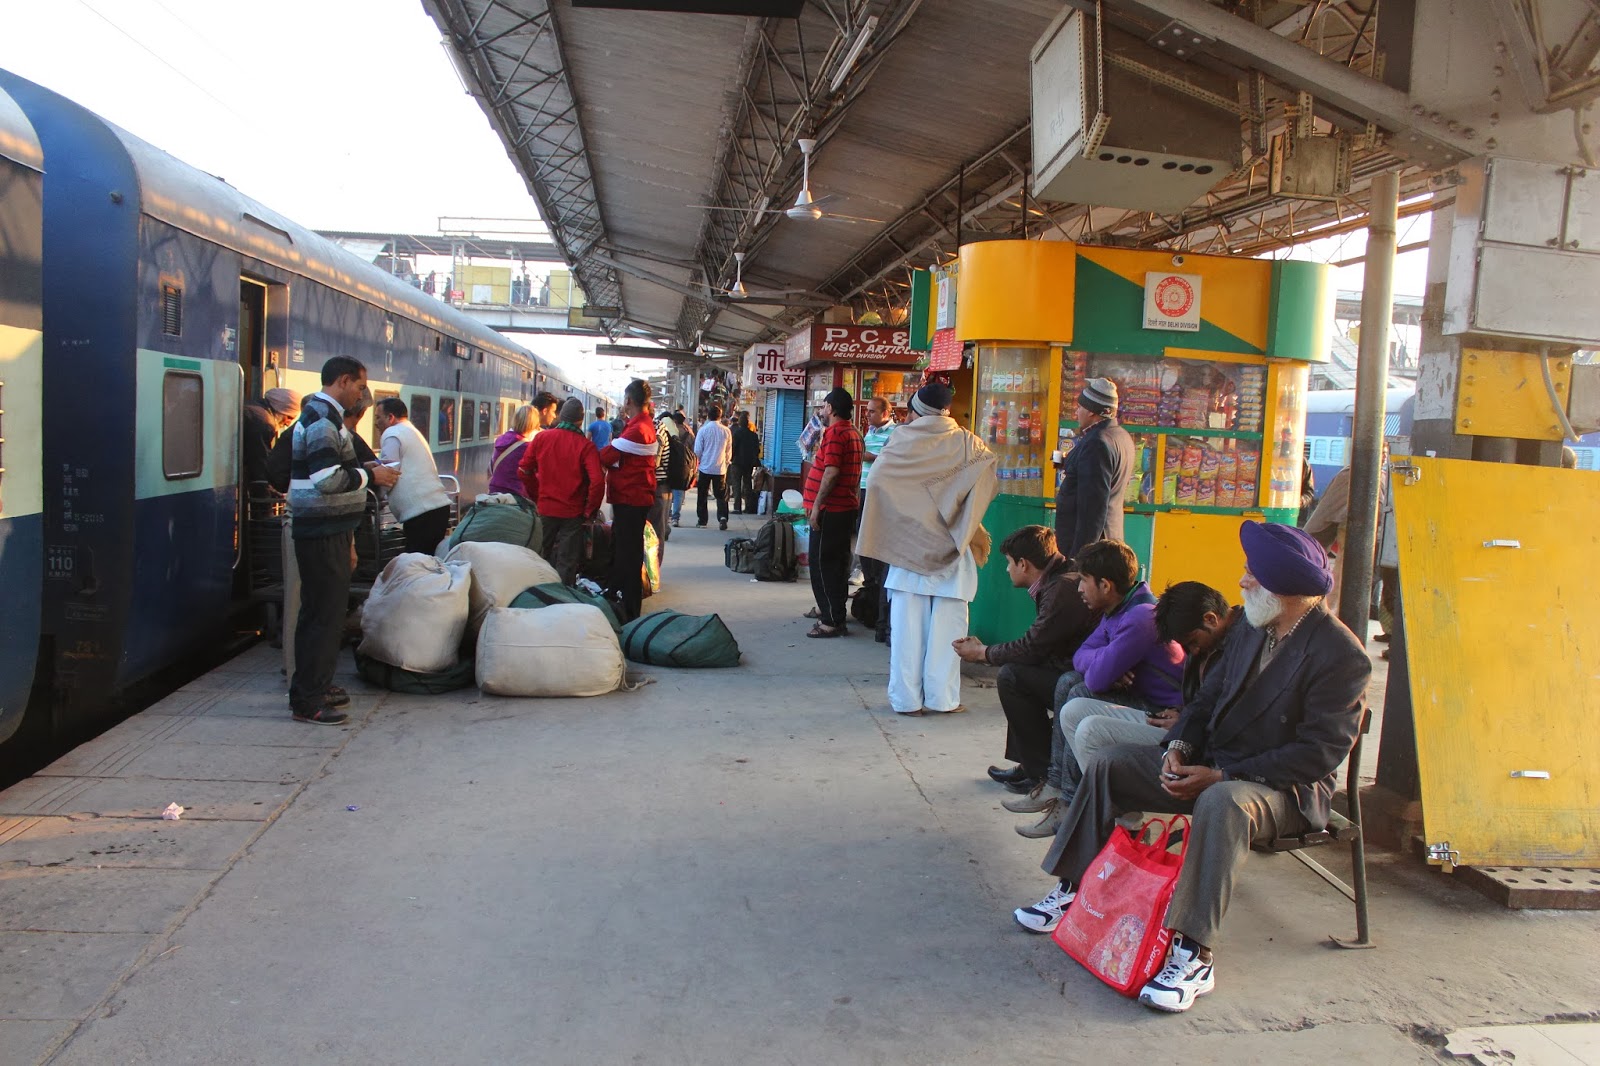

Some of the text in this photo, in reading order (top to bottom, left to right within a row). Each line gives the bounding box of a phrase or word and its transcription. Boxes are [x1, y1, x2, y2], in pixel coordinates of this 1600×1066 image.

[821, 342, 863, 353] MISC.
[756, 373, 779, 385] बुक
[782, 374, 807, 386] स्टा
[48, 556, 73, 571] 110
